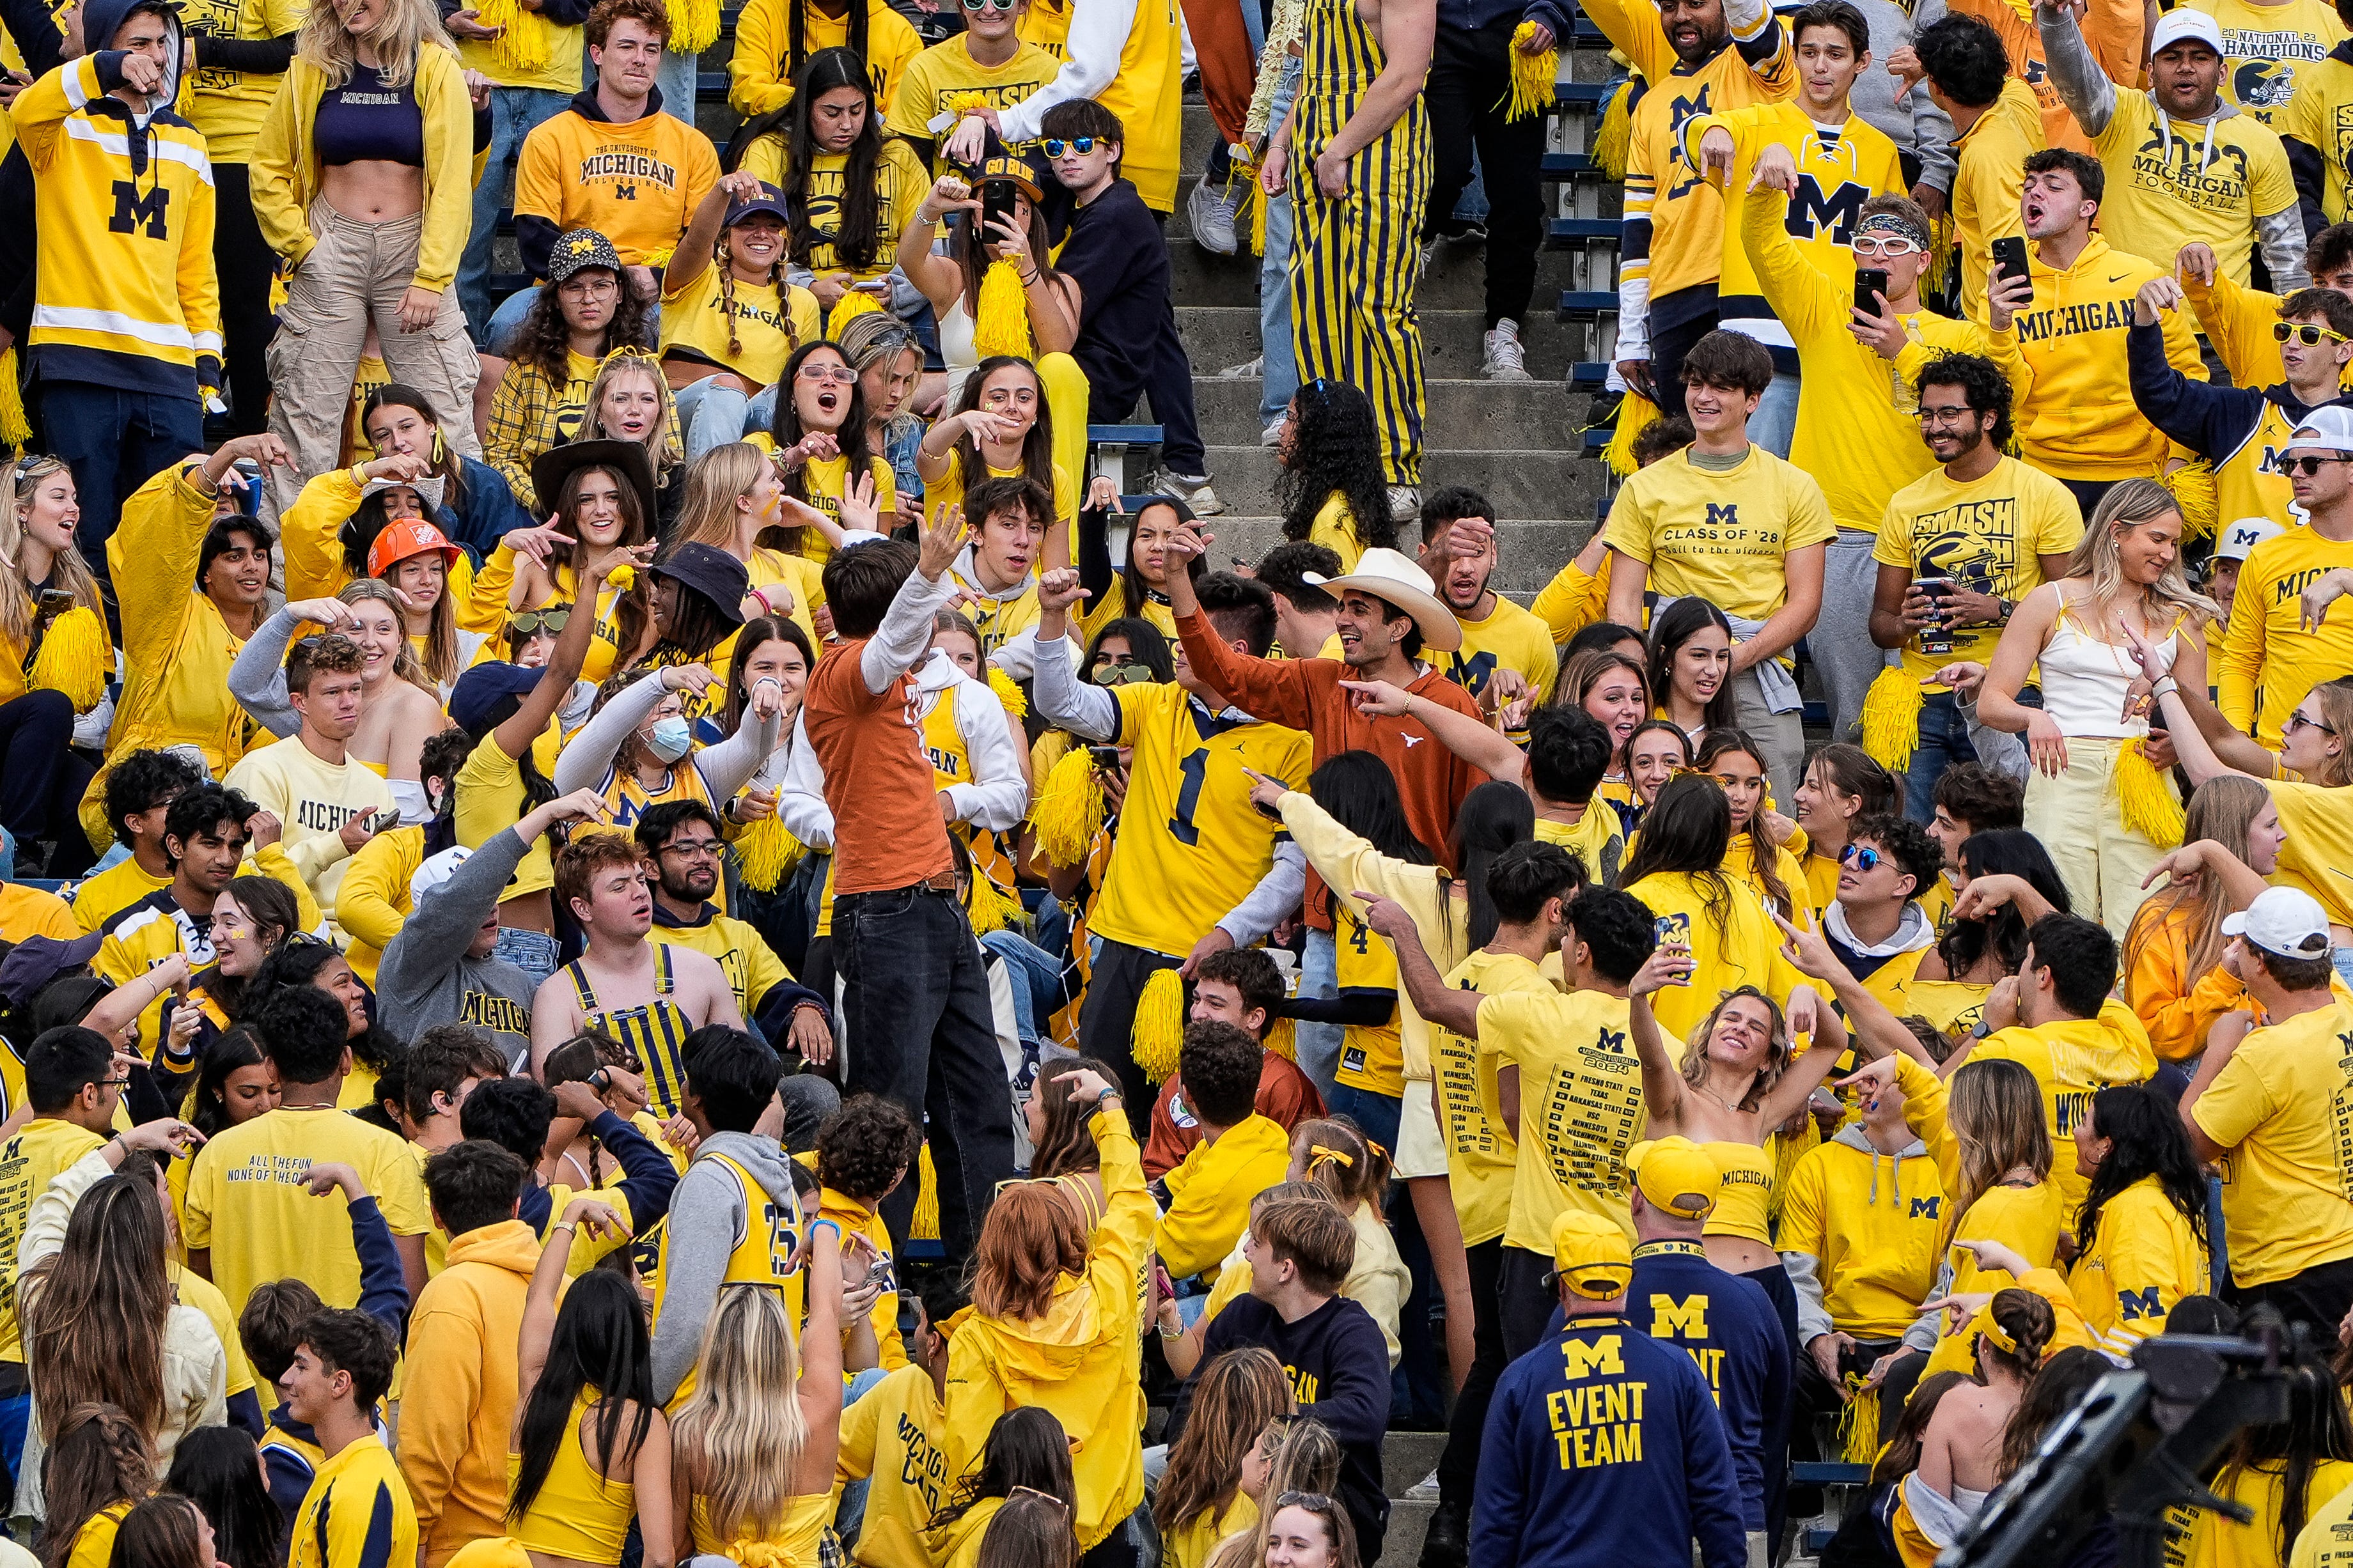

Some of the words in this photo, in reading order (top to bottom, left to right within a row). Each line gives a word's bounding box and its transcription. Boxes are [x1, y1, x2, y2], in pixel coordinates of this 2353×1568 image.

[2223, 28, 2235, 36] 20
[2239, 31, 2299, 43] NATIONAL
[2304, 33, 2316, 42] 23
[2221, 39, 2327, 62] HAMPIONS
[340, 92, 401, 105] MICHIGAN
[595, 144, 607, 154] THE
[609, 144, 648, 155] UNIVERSITY
[650, 149, 657, 157] OF
[580, 153, 677, 190] MICHIGAN
[985, 158, 1005, 175] GO
[1006, 157, 1035, 181] BLUE
[2132, 155, 2246, 198] MICHIGAN
[585, 177, 668, 195] WOLVERINES
[616, 184, 636, 201] M
[2134, 171, 2239, 210] FOOTBALL
[108, 180, 169, 242] M
[1785, 172, 1872, 246] M
[569, 237, 595, 255] M
[2014, 298, 2137, 344] MICHIGAN
[1705, 502, 1739, 525] M
[1916, 499, 2014, 535] SMASH
[1664, 528, 1719, 541] CLASS
[1725, 529, 1748, 540] OF
[1754, 530, 1779, 543] '28
[2233, 528, 2261, 546] M
[1168, 747, 1211, 848] 1
[231, 929, 246, 940] M
[1348, 923, 1369, 955] 4
[1596, 1026, 1626, 1054] M
[1584, 1057, 1629, 1076] 2024
[1580, 1075, 1604, 1087] FRESNO
[1606, 1080, 1624, 1092] STATE
[1590, 1088, 1609, 1099] TEXAS
[1568, 1095, 1604, 1110] ARKANSAS
[1604, 1104, 1623, 1115] STATE
[1586, 1111, 1600, 1121] USC
[1567, 1128, 1609, 1144] WASHINGTON
[1572, 1119, 1608, 1134] MINNESOTA
[249, 1154, 268, 1167] ALL
[228, 1168, 253, 1181] NONE
[256, 1169, 270, 1181] OF
[1721, 1169, 1774, 1194] MICHIGAN
[1909, 1196, 1941, 1220] M
[2118, 1285, 2166, 1321] M
[1650, 1294, 1708, 1339] M
[1561, 1335, 1625, 1381] M
[1547, 1382, 1648, 1431] EVENT
[1554, 1423, 1643, 1470] TEAM
